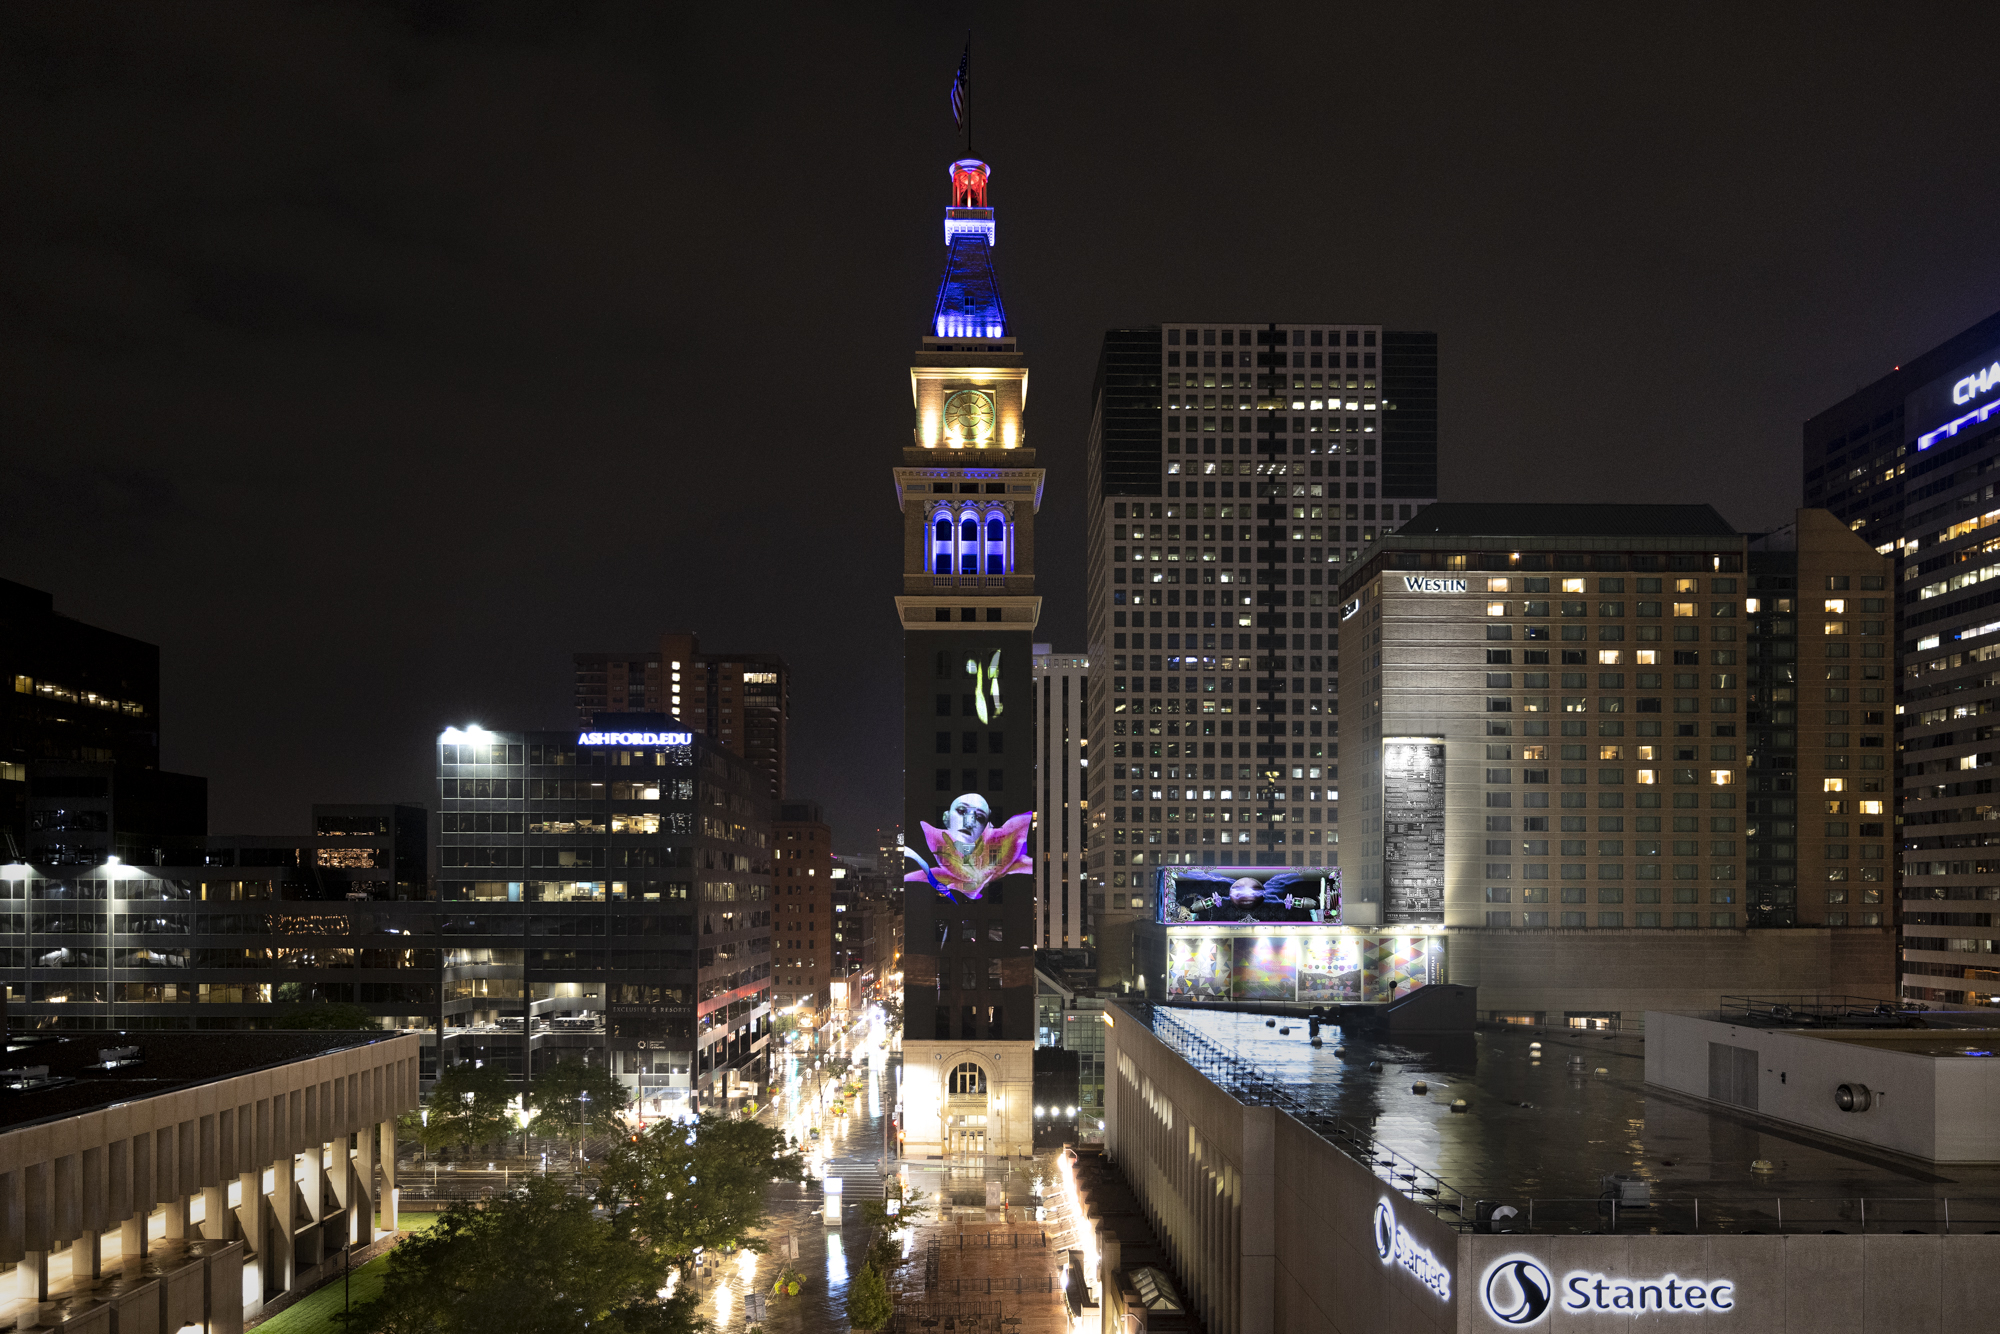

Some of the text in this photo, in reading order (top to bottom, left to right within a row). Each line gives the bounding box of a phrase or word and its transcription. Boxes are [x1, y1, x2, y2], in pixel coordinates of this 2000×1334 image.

[1404, 576, 1467, 592] WESTIN
[578, 732, 693, 745] ASHFORD.EDU
[1394, 1227, 1449, 1299] Stantec
[1566, 1275, 1734, 1311] Stantec
